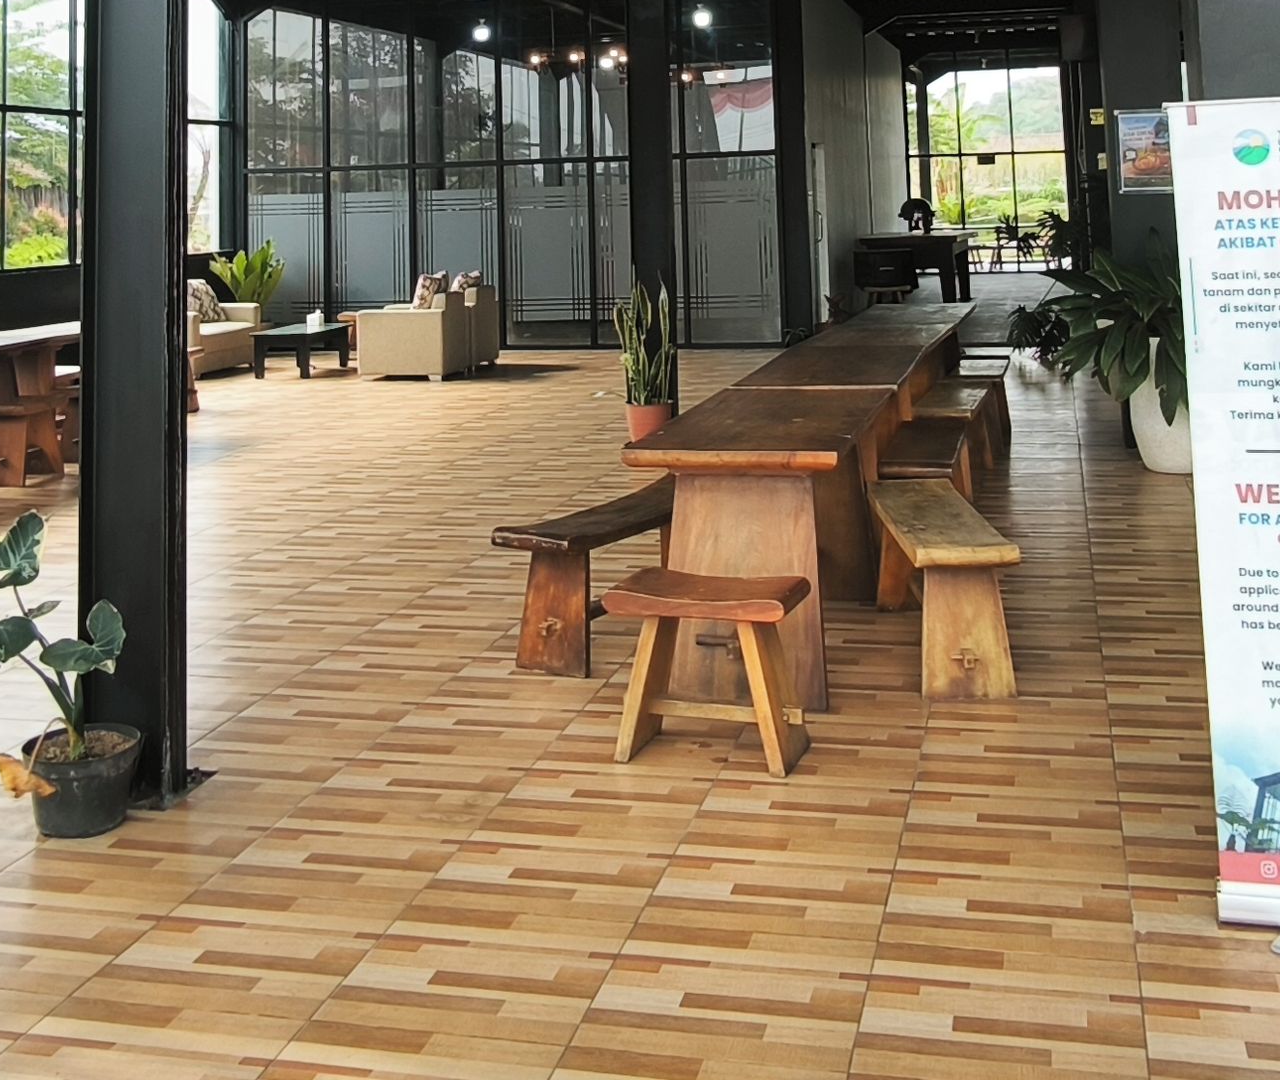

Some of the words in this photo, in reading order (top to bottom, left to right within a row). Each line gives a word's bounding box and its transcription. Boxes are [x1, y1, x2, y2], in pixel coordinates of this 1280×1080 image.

[1214, 218, 1256, 230] ATAS
[1217, 237, 1276, 249] AKIBAT
[1212, 271, 1238, 280] Saat
[1242, 270, 1260, 280] ini,
[1203, 288, 1244, 296] tanam
[1248, 286, 1270, 296] dan
[1219, 302, 1231, 313] di
[1234, 302, 1275, 312] sekitar
[1244, 361, 1276, 370] Kami
[1230, 410, 1274, 420] Terima
[1235, 484, 1280, 503] WE
[1239, 513, 1270, 524] FOR
[1238, 568, 1263, 578] Due
[1266, 568, 1278, 578] to
[1233, 603, 1278, 613] around
[1241, 620, 1264, 631] has
